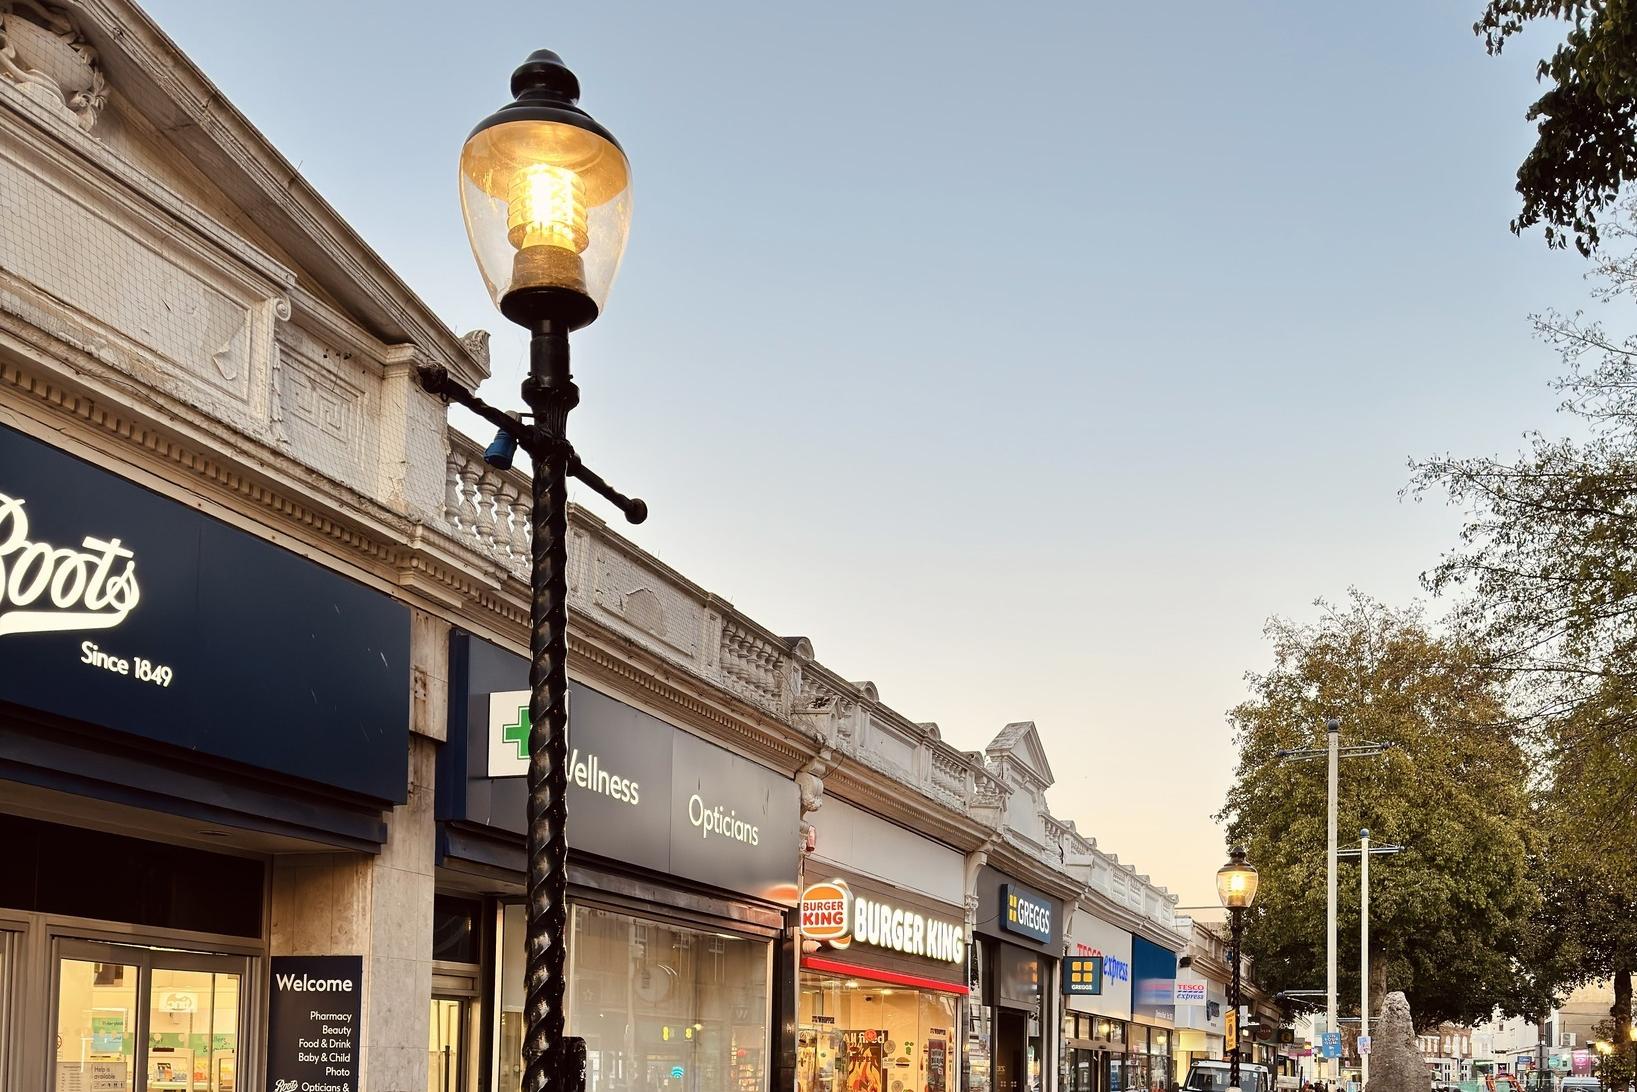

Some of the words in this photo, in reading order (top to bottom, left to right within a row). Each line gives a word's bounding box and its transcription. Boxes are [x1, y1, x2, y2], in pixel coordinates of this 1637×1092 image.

[81, 641, 129, 676] Since
[134, 656, 173, 687] 1849
[567, 749, 640, 805] ellness
[688, 794, 759, 846] Opticians
[803, 901, 844, 912] BURGER
[802, 912, 844, 926] KING
[1017, 898, 1050, 935] GREGGS
[854, 897, 924, 956] BURGER
[926, 918, 963, 964] KING
[1103, 955, 1128, 986] express
[276, 973, 353, 992] Welcome
[1176, 993, 1205, 1001] express
[310, 1010, 353, 1023] Pharmacy
[322, 1025, 352, 1037] Beauty
[298, 1038, 320, 1049] Food
[320, 1038, 328, 1049] &
[329, 1038, 352, 1049] Drink
[298, 1052, 320, 1065] Baby
[320, 1052, 328, 1062] &
[328, 1052, 351, 1063] Child
[325, 1066, 351, 1077] Photo
[301, 1082, 341, 1092] Opticians
